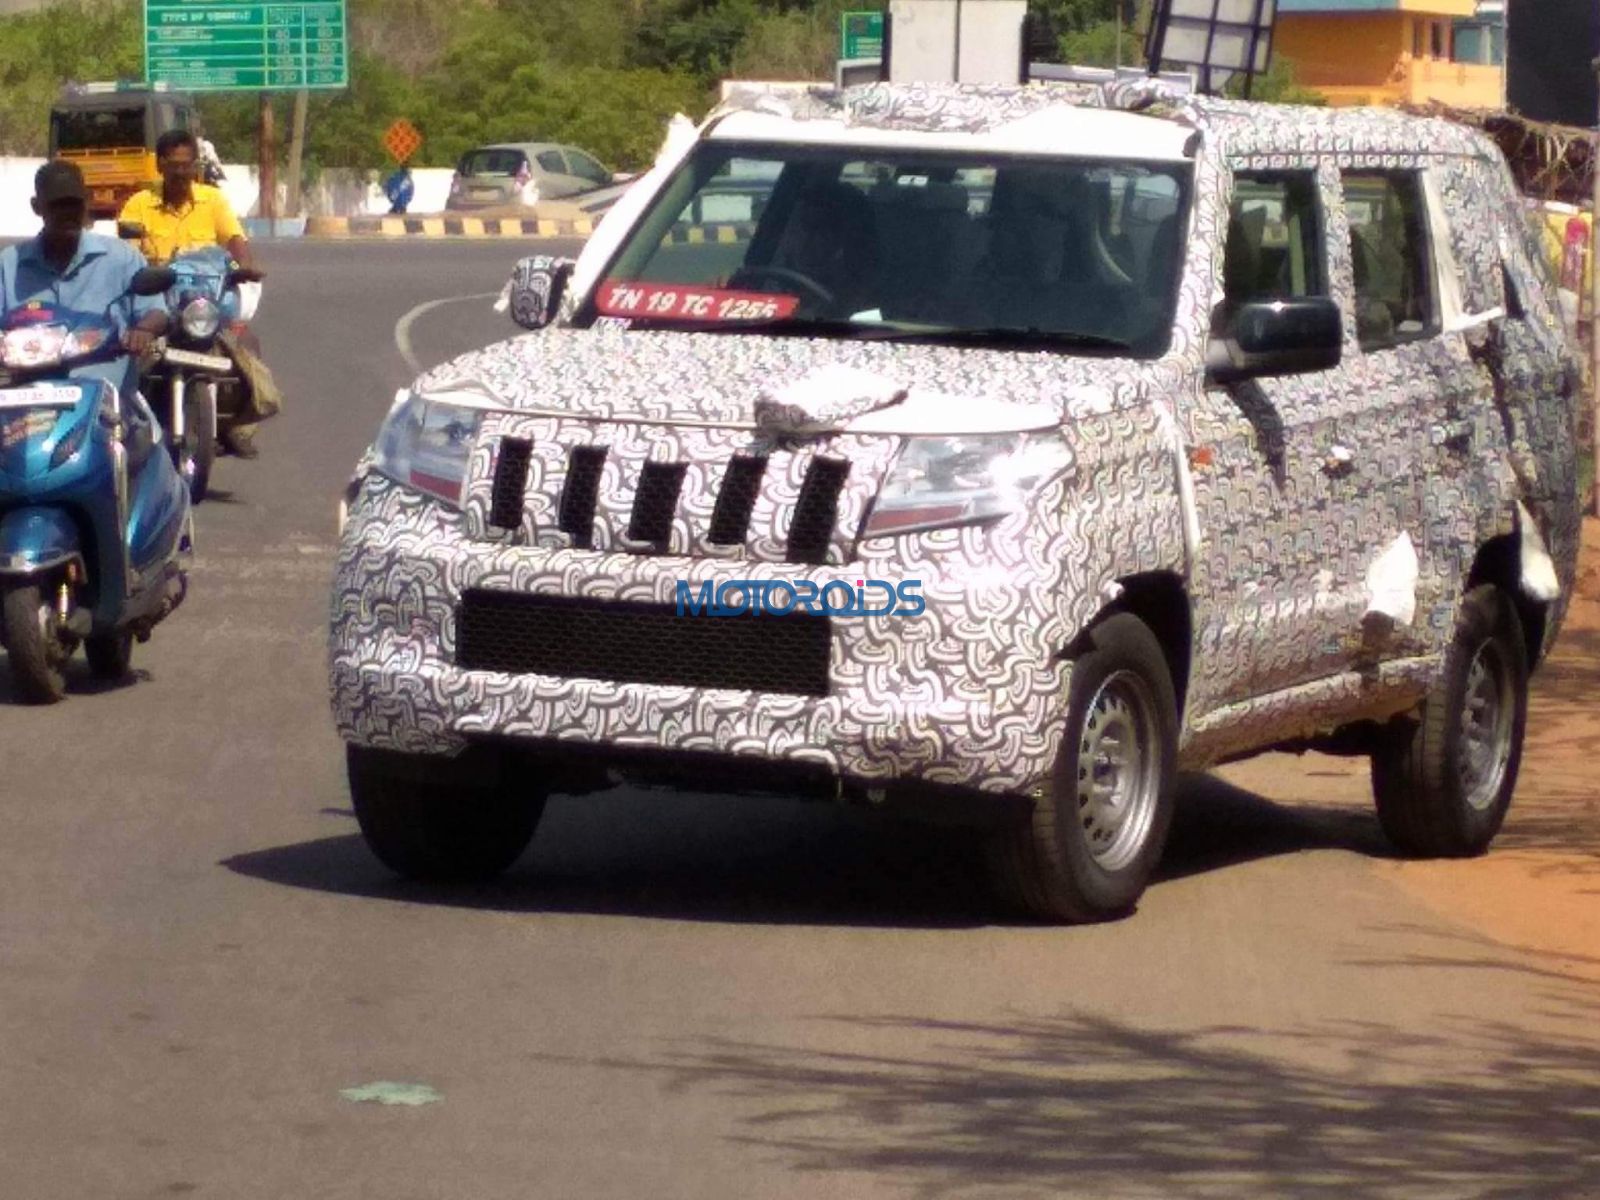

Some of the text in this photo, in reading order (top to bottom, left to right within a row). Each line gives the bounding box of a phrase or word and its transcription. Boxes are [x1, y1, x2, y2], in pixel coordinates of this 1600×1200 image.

[607, 287, 643, 309] TN
[646, 291, 677, 311] 19
[681, 295, 714, 315] TC
